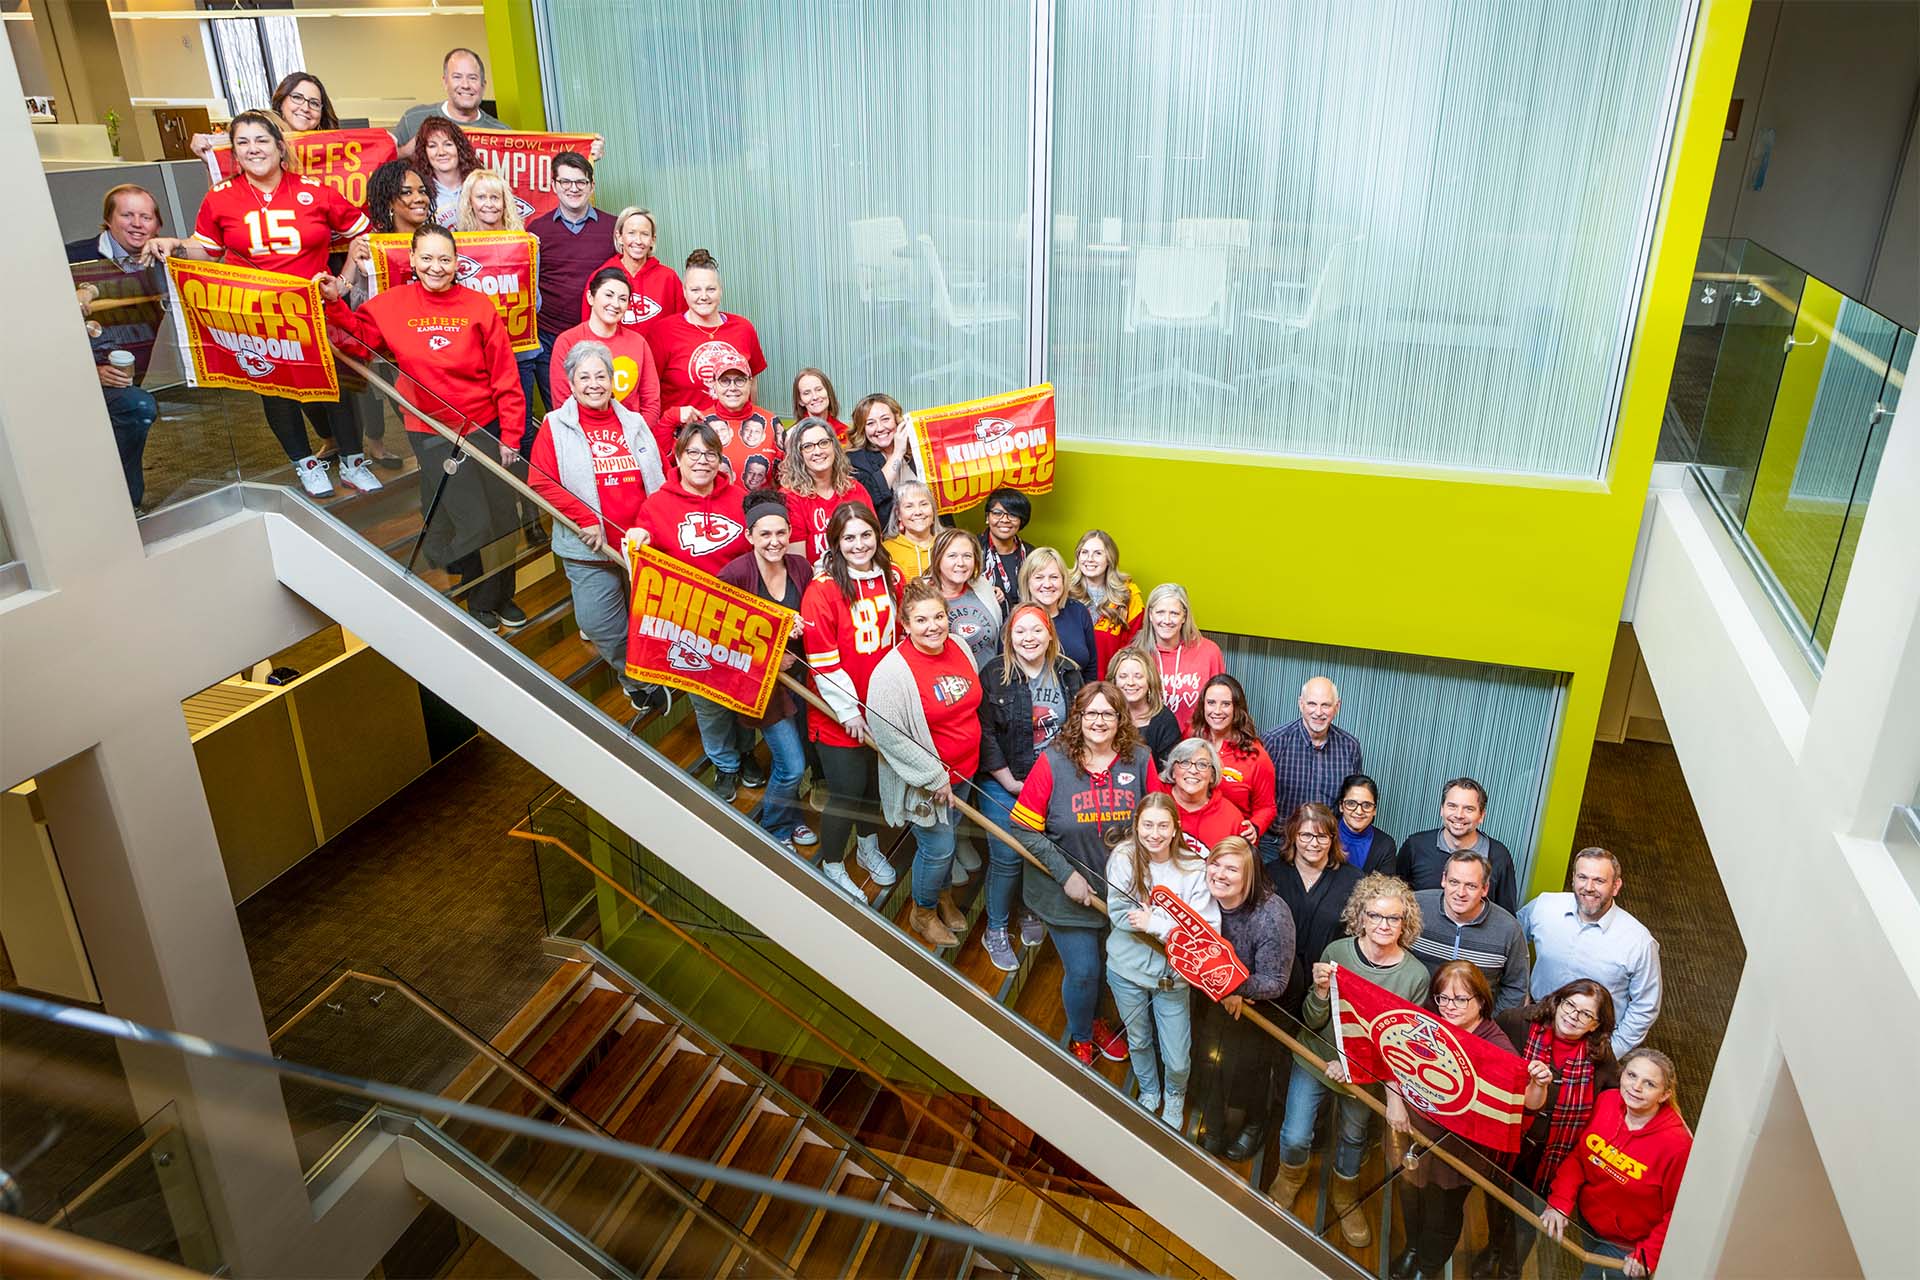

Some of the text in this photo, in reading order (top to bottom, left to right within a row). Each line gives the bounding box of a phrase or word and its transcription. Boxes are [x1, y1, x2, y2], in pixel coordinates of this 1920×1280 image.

[504, 137, 544, 152] BOWL
[551, 143, 575, 153] LIV
[243, 208, 301, 256] 15
[198, 265, 231, 278] KINGDOM
[183, 278, 313, 349] CHIEFS
[407, 315, 470, 328] CHIEFS
[417, 325, 460, 333] KANSAS CITY
[694, 520, 730, 544] KC
[657, 556, 693, 579] KINGDOM
[694, 573, 722, 589] CHIEFS
[722, 585, 759, 605] KINGDOM
[633, 566, 774, 668] CHIEFS
[849, 594, 894, 655] 87
[639, 614, 753, 673] KINGDOM
[1036, 687, 1060, 705] THE
[1071, 788, 1135, 813] CHIEFS
[1112, 810, 1132, 821] CITY
[1375, 1016, 1398, 1031] 1960
[1393, 1068, 1446, 1101] SEASONS
[1585, 1133, 1649, 1181] CHIEFS
